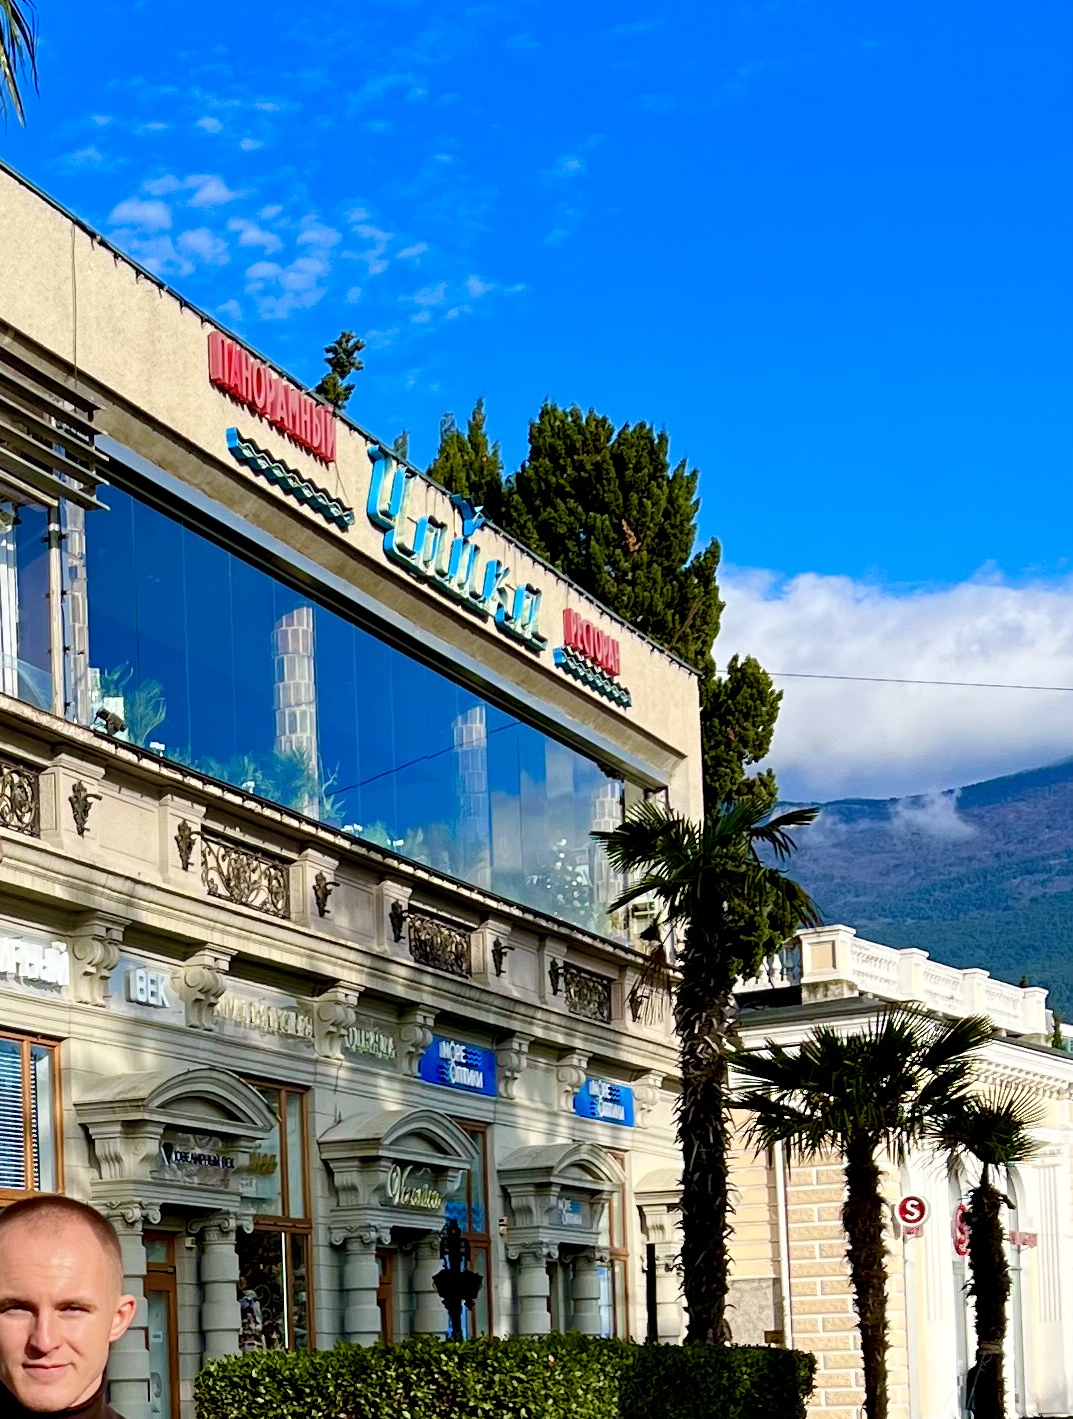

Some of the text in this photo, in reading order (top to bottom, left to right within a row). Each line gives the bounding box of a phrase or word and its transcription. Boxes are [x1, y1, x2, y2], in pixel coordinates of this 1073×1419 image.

[208, 330, 337, 463] ПАНОРАМНЫЙ
[563, 607, 621, 677] РЕСТОРАН
[129, 966, 170, 1008] ВЕК
[439, 1041, 466, 1063] МОРЕ
